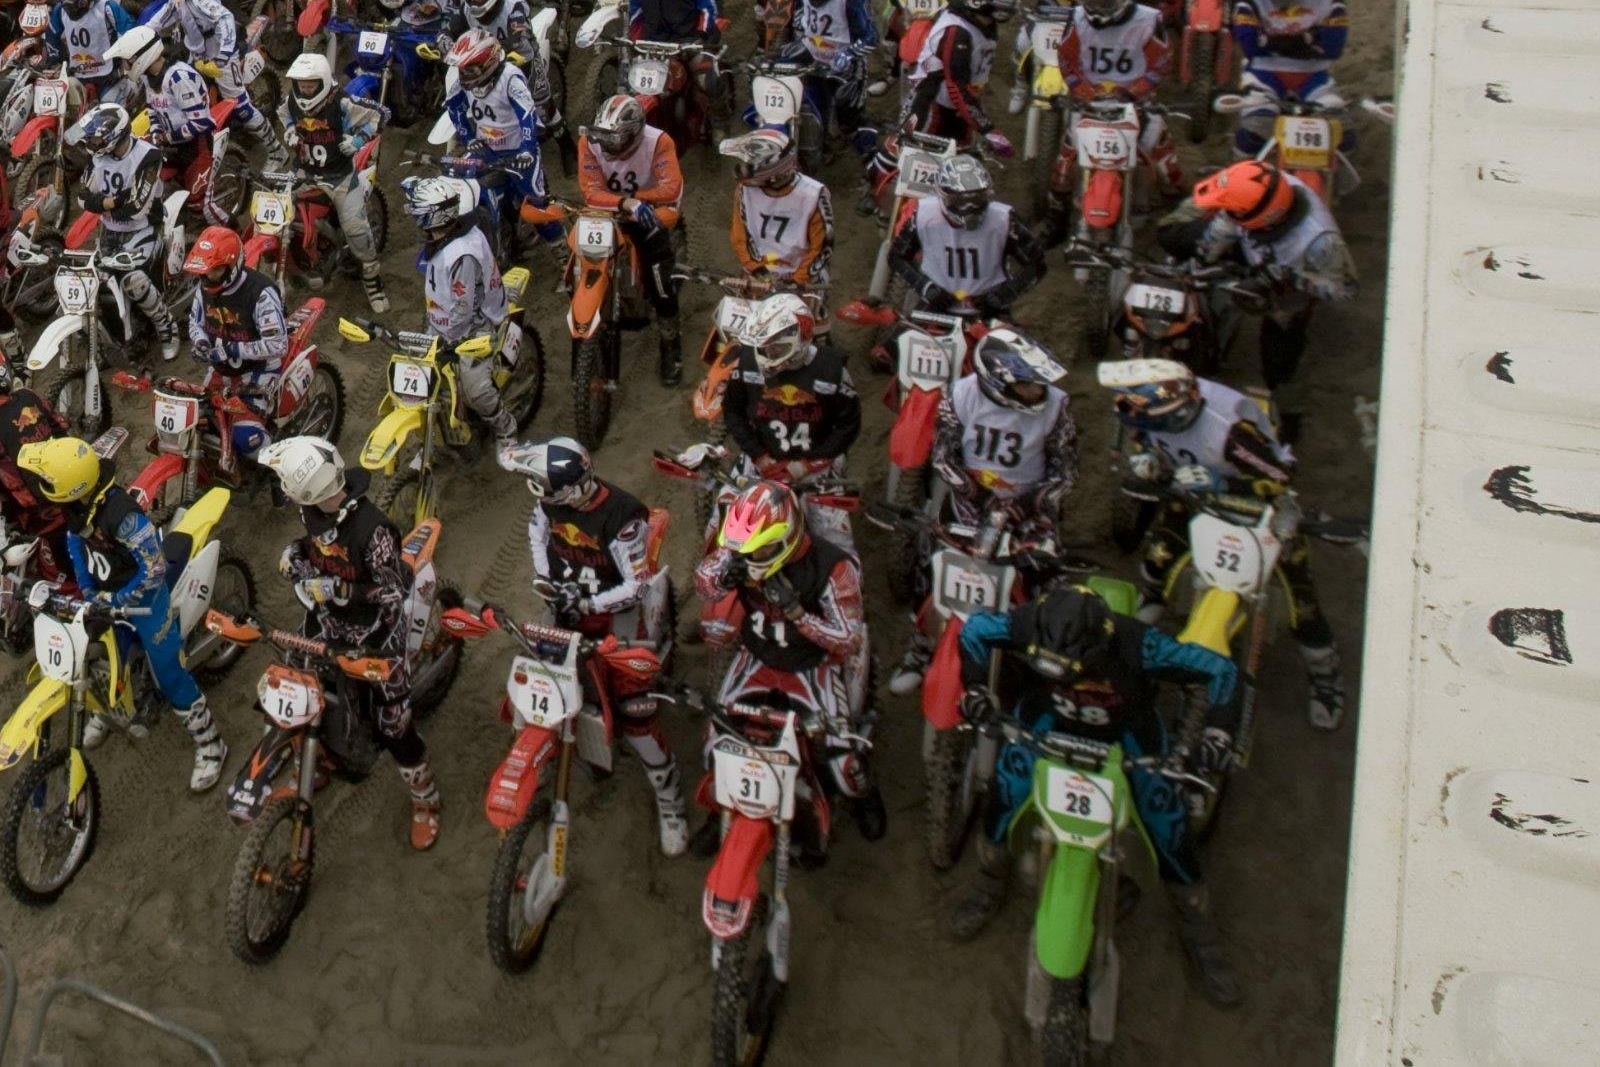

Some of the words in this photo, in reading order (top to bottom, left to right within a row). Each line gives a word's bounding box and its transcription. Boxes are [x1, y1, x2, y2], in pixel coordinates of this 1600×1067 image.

[25, 14, 39, 26] 135
[71, 27, 91, 48] 60
[365, 41, 376, 52] 90
[1089, 47, 1132, 75] 156
[640, 76, 653, 87] 89
[42, 95, 52, 106] 60
[471, 98, 496, 121] 64
[765, 95, 784, 108] 132
[1096, 141, 1120, 154] 156
[607, 172, 638, 193] 63
[264, 209, 276, 222] 49
[759, 214, 789, 242] 77
[588, 232, 602, 245] 63
[945, 246, 979, 279] 111
[67, 288, 79, 300] 59
[731, 314, 745, 328] 77
[918, 358, 942, 376] 111
[403, 378, 418, 393] 74
[162, 415, 174, 431] 40
[770, 420, 811, 452] 34
[973, 424, 1023, 468] 113
[1215, 552, 1240, 572] 52
[954, 583, 985, 604] 113
[412, 617, 424, 634] 16
[48, 649, 61, 666] 10
[278, 698, 294, 717] 16
[531, 694, 549, 714] 14
[740, 779, 761, 800] 31
[1065, 792, 1091, 816] 28
